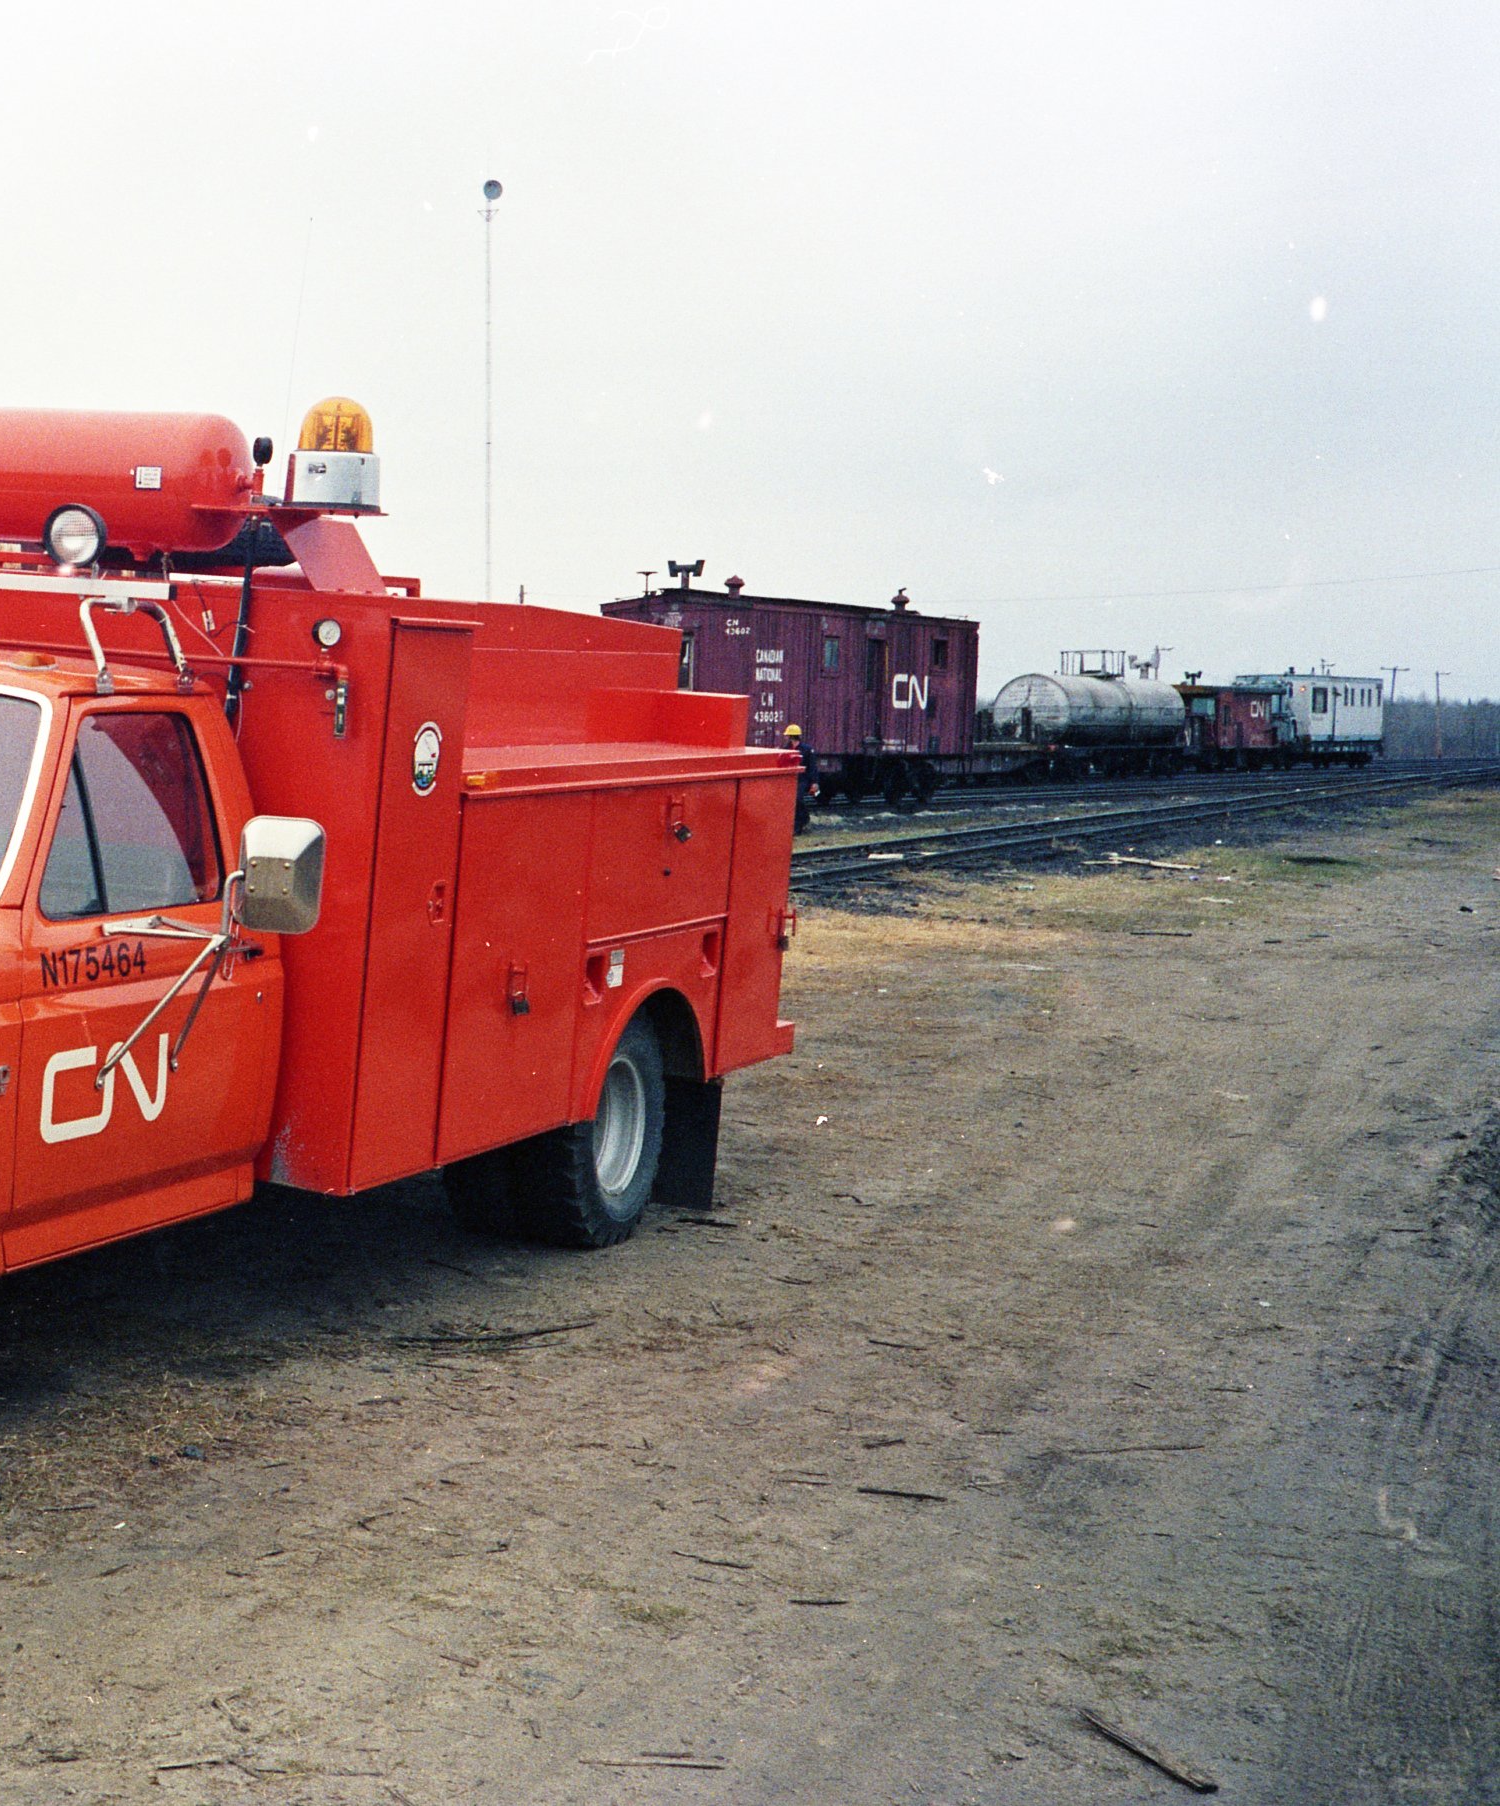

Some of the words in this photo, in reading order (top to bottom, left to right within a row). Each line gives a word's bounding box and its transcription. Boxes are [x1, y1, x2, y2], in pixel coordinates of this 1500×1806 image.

[726, 619, 739, 627] CN
[756, 649, 784, 663] CANADIAN
[755, 667, 783, 682] NATIONAL
[761, 692, 773, 707] CN
[892, 673, 928, 710] CN
[1250, 700, 1265, 718] CN
[40, 941, 147, 988] N175464
[40, 1033, 169, 1144] CN
